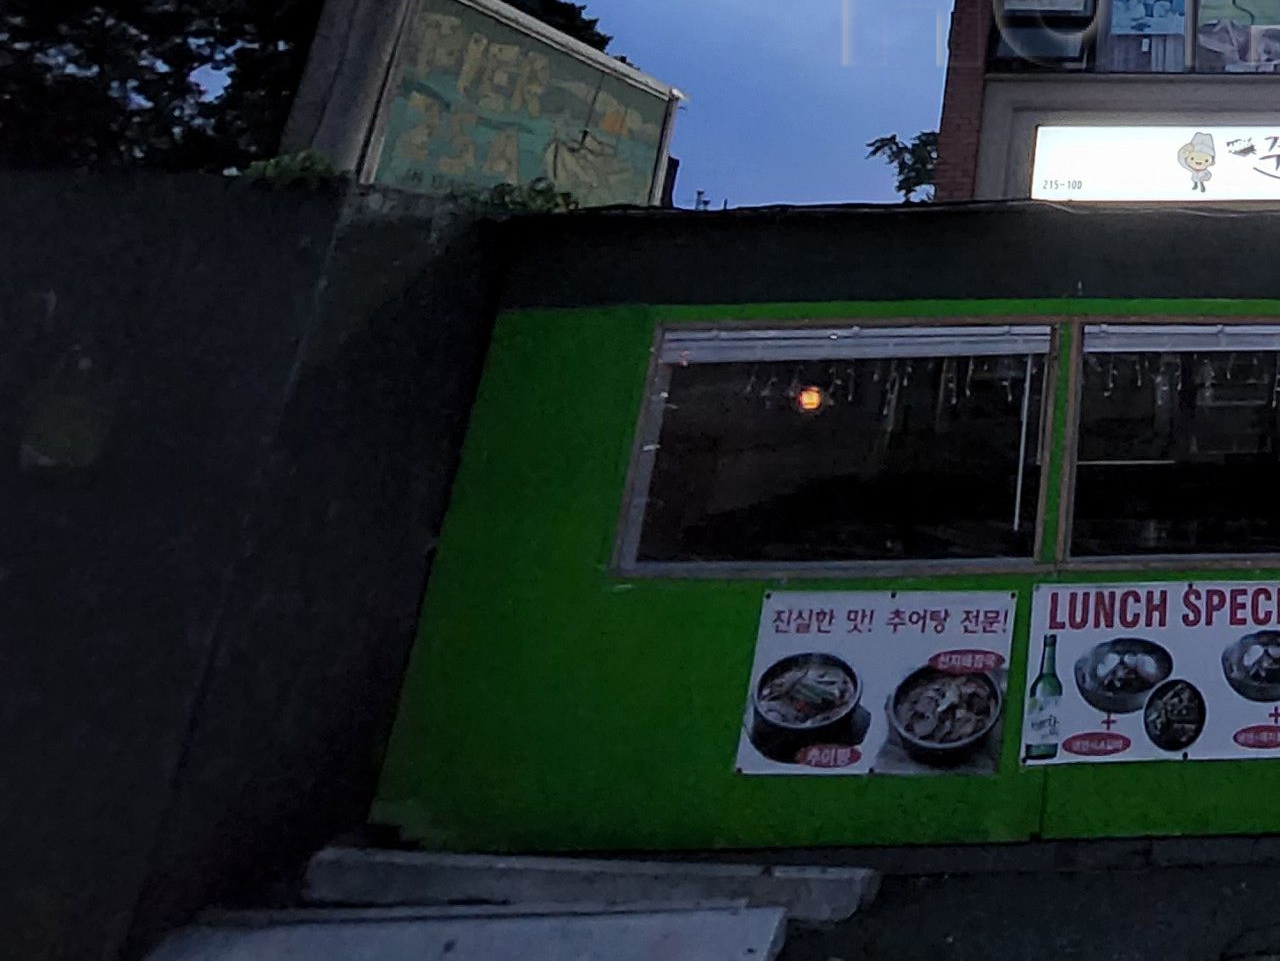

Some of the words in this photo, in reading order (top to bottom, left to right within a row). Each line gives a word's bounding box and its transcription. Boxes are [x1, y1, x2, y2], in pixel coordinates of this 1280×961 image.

[772, 608, 836, 635] 진실한
[846, 608, 875, 635] 맛!
[885, 607, 952, 635] 추어탕
[960, 608, 1009, 635] 전문!
[1048, 589, 1168, 630] LUNCH
